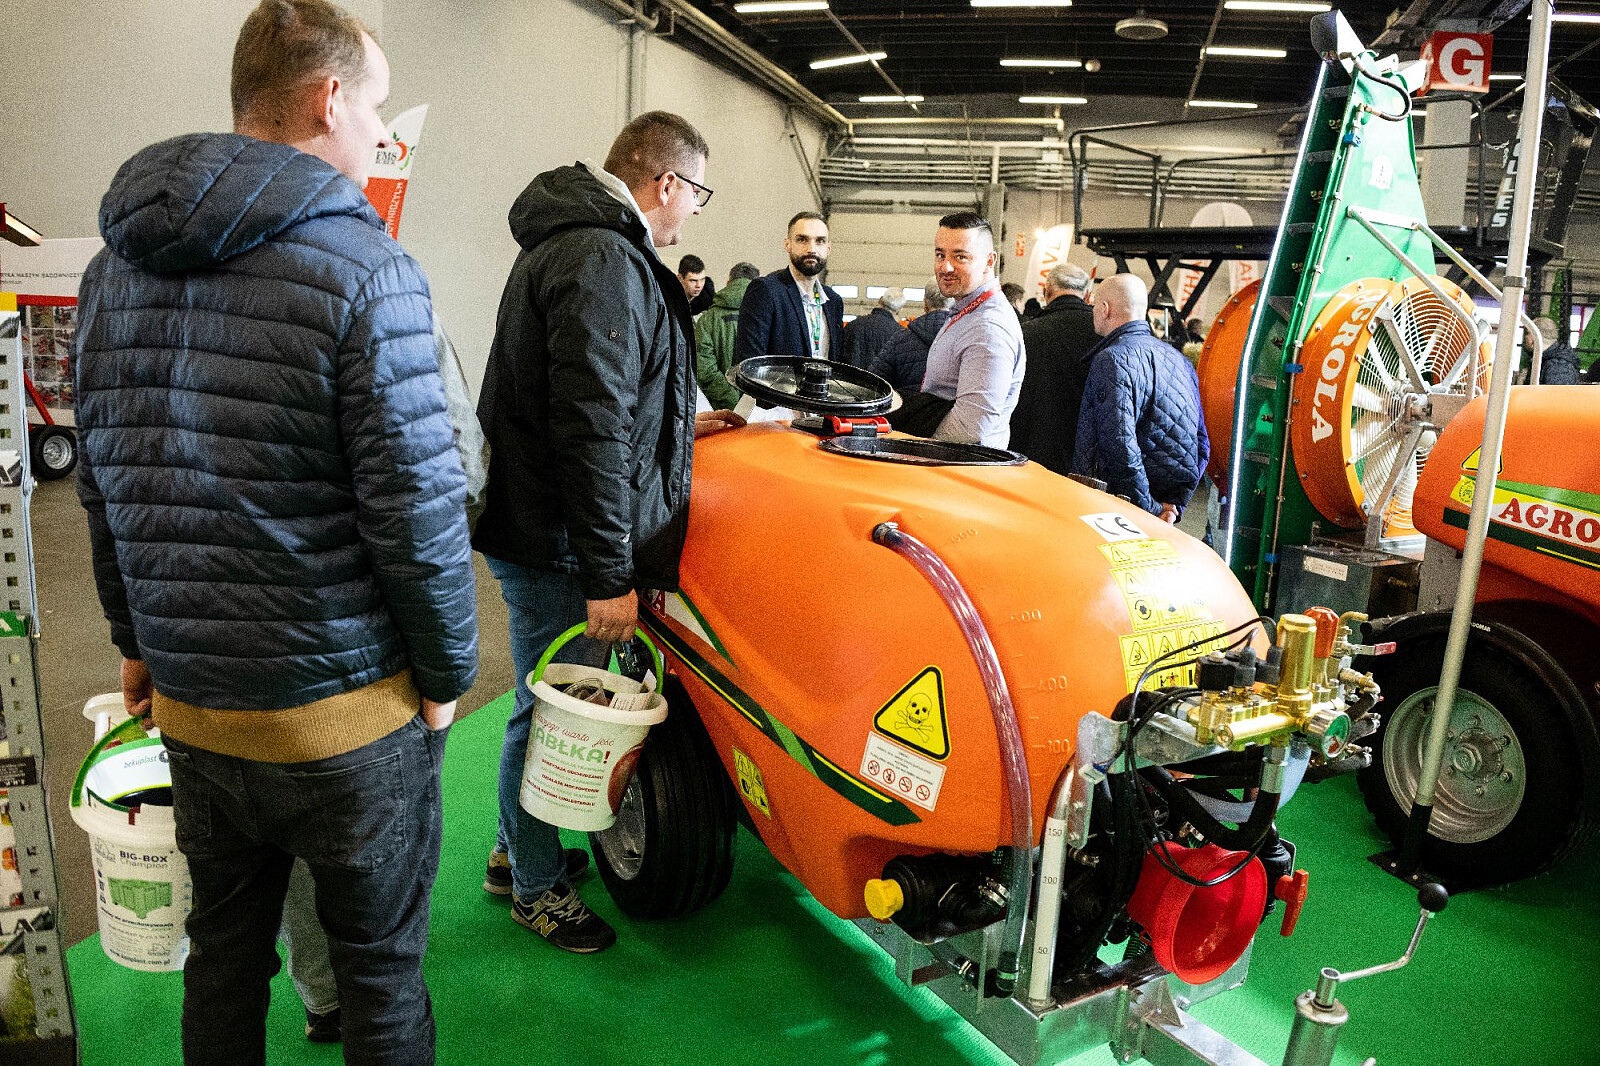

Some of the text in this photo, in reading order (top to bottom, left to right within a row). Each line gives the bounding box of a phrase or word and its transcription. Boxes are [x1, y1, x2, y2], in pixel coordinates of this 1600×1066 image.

[1439, 37, 1485, 87] G
[1311, 298, 1379, 444] GROLA
[1048, 828, 1063, 837] 150
[119, 850, 168, 863] BIG-BOX
[1042, 876, 1058, 885] 100
[1037, 947, 1048, 955] 50
